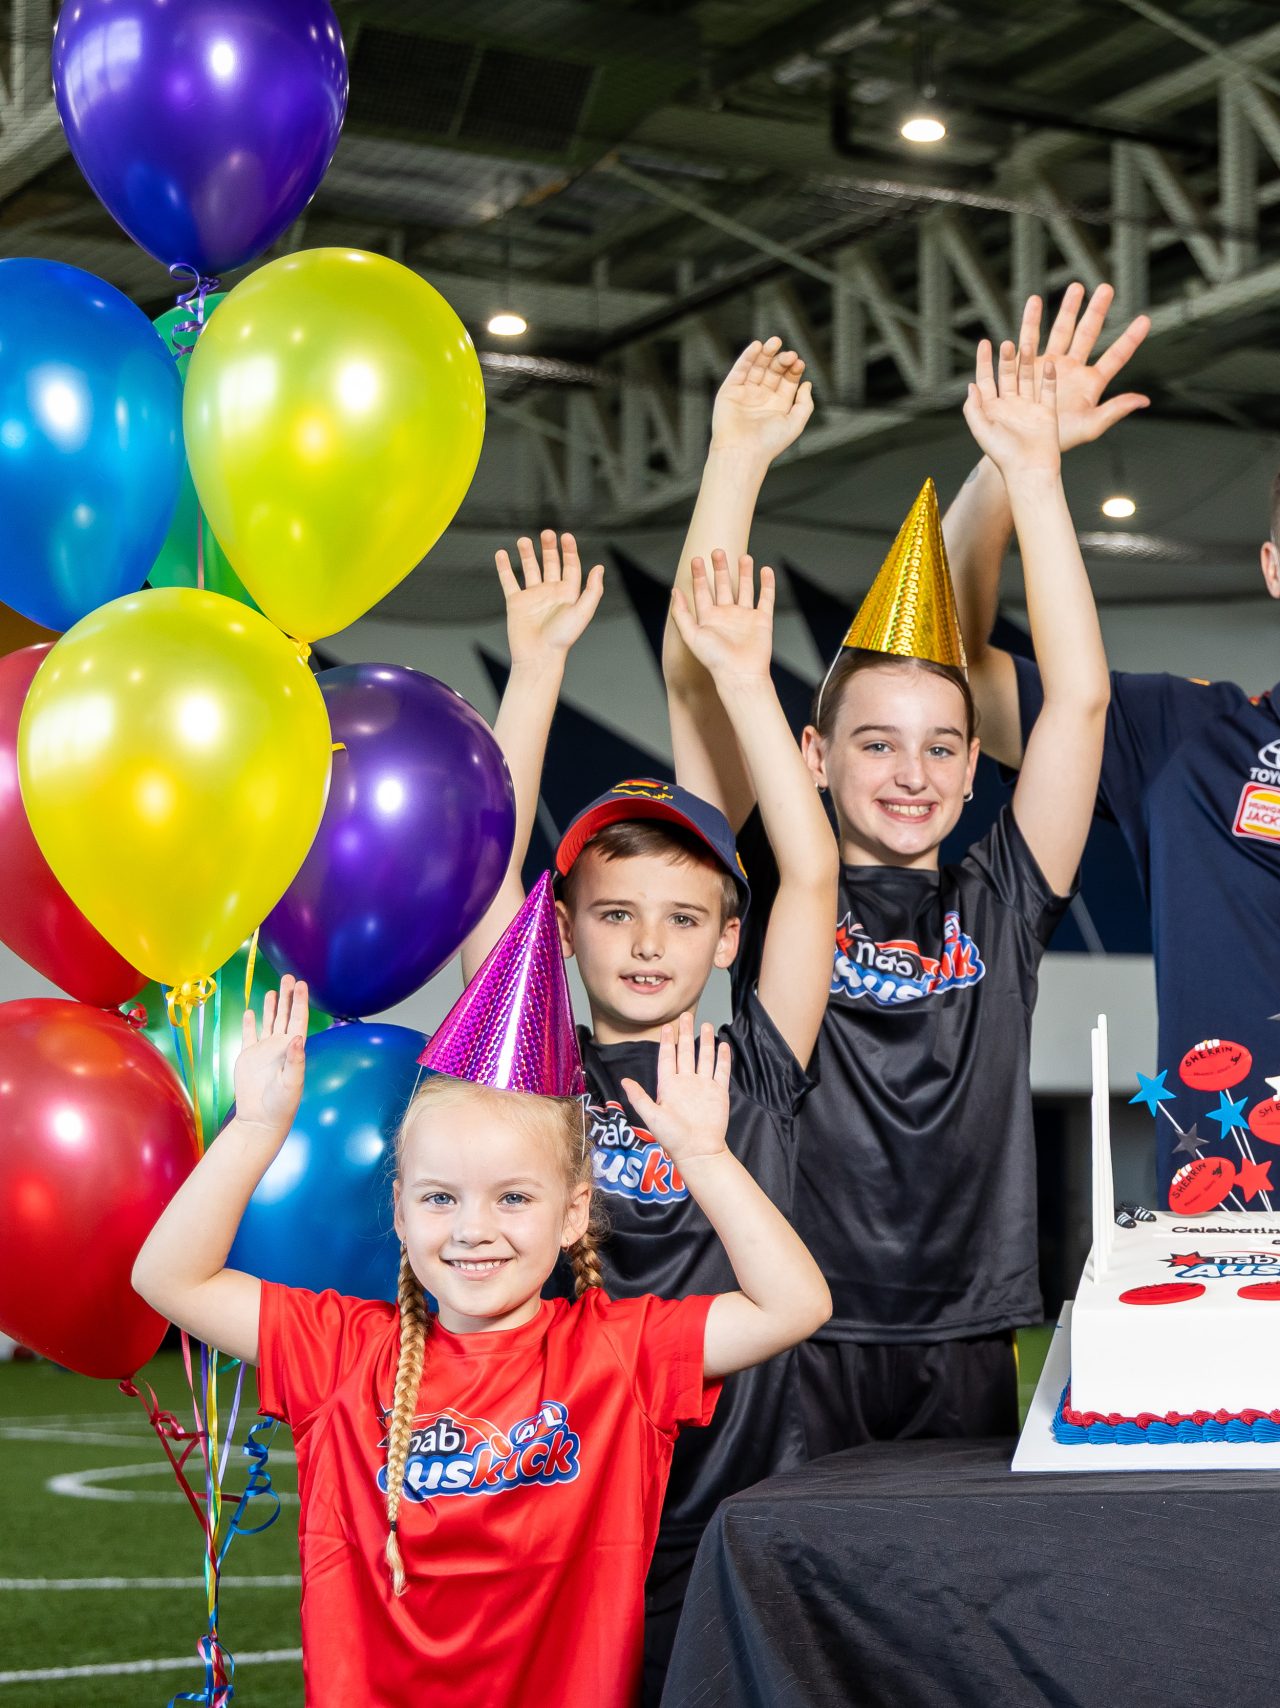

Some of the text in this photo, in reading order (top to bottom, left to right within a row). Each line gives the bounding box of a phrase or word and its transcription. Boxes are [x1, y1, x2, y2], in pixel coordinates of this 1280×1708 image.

[856, 941, 914, 977] nab
[1185, 1046, 1233, 1067] SHERRIN
[590, 1117, 635, 1146] nab
[1171, 1162, 1207, 1199] SHERRIN
[1213, 1254, 1273, 1265] nab
[515, 1407, 563, 1445] AFL
[407, 1429, 573, 1490] uskick
